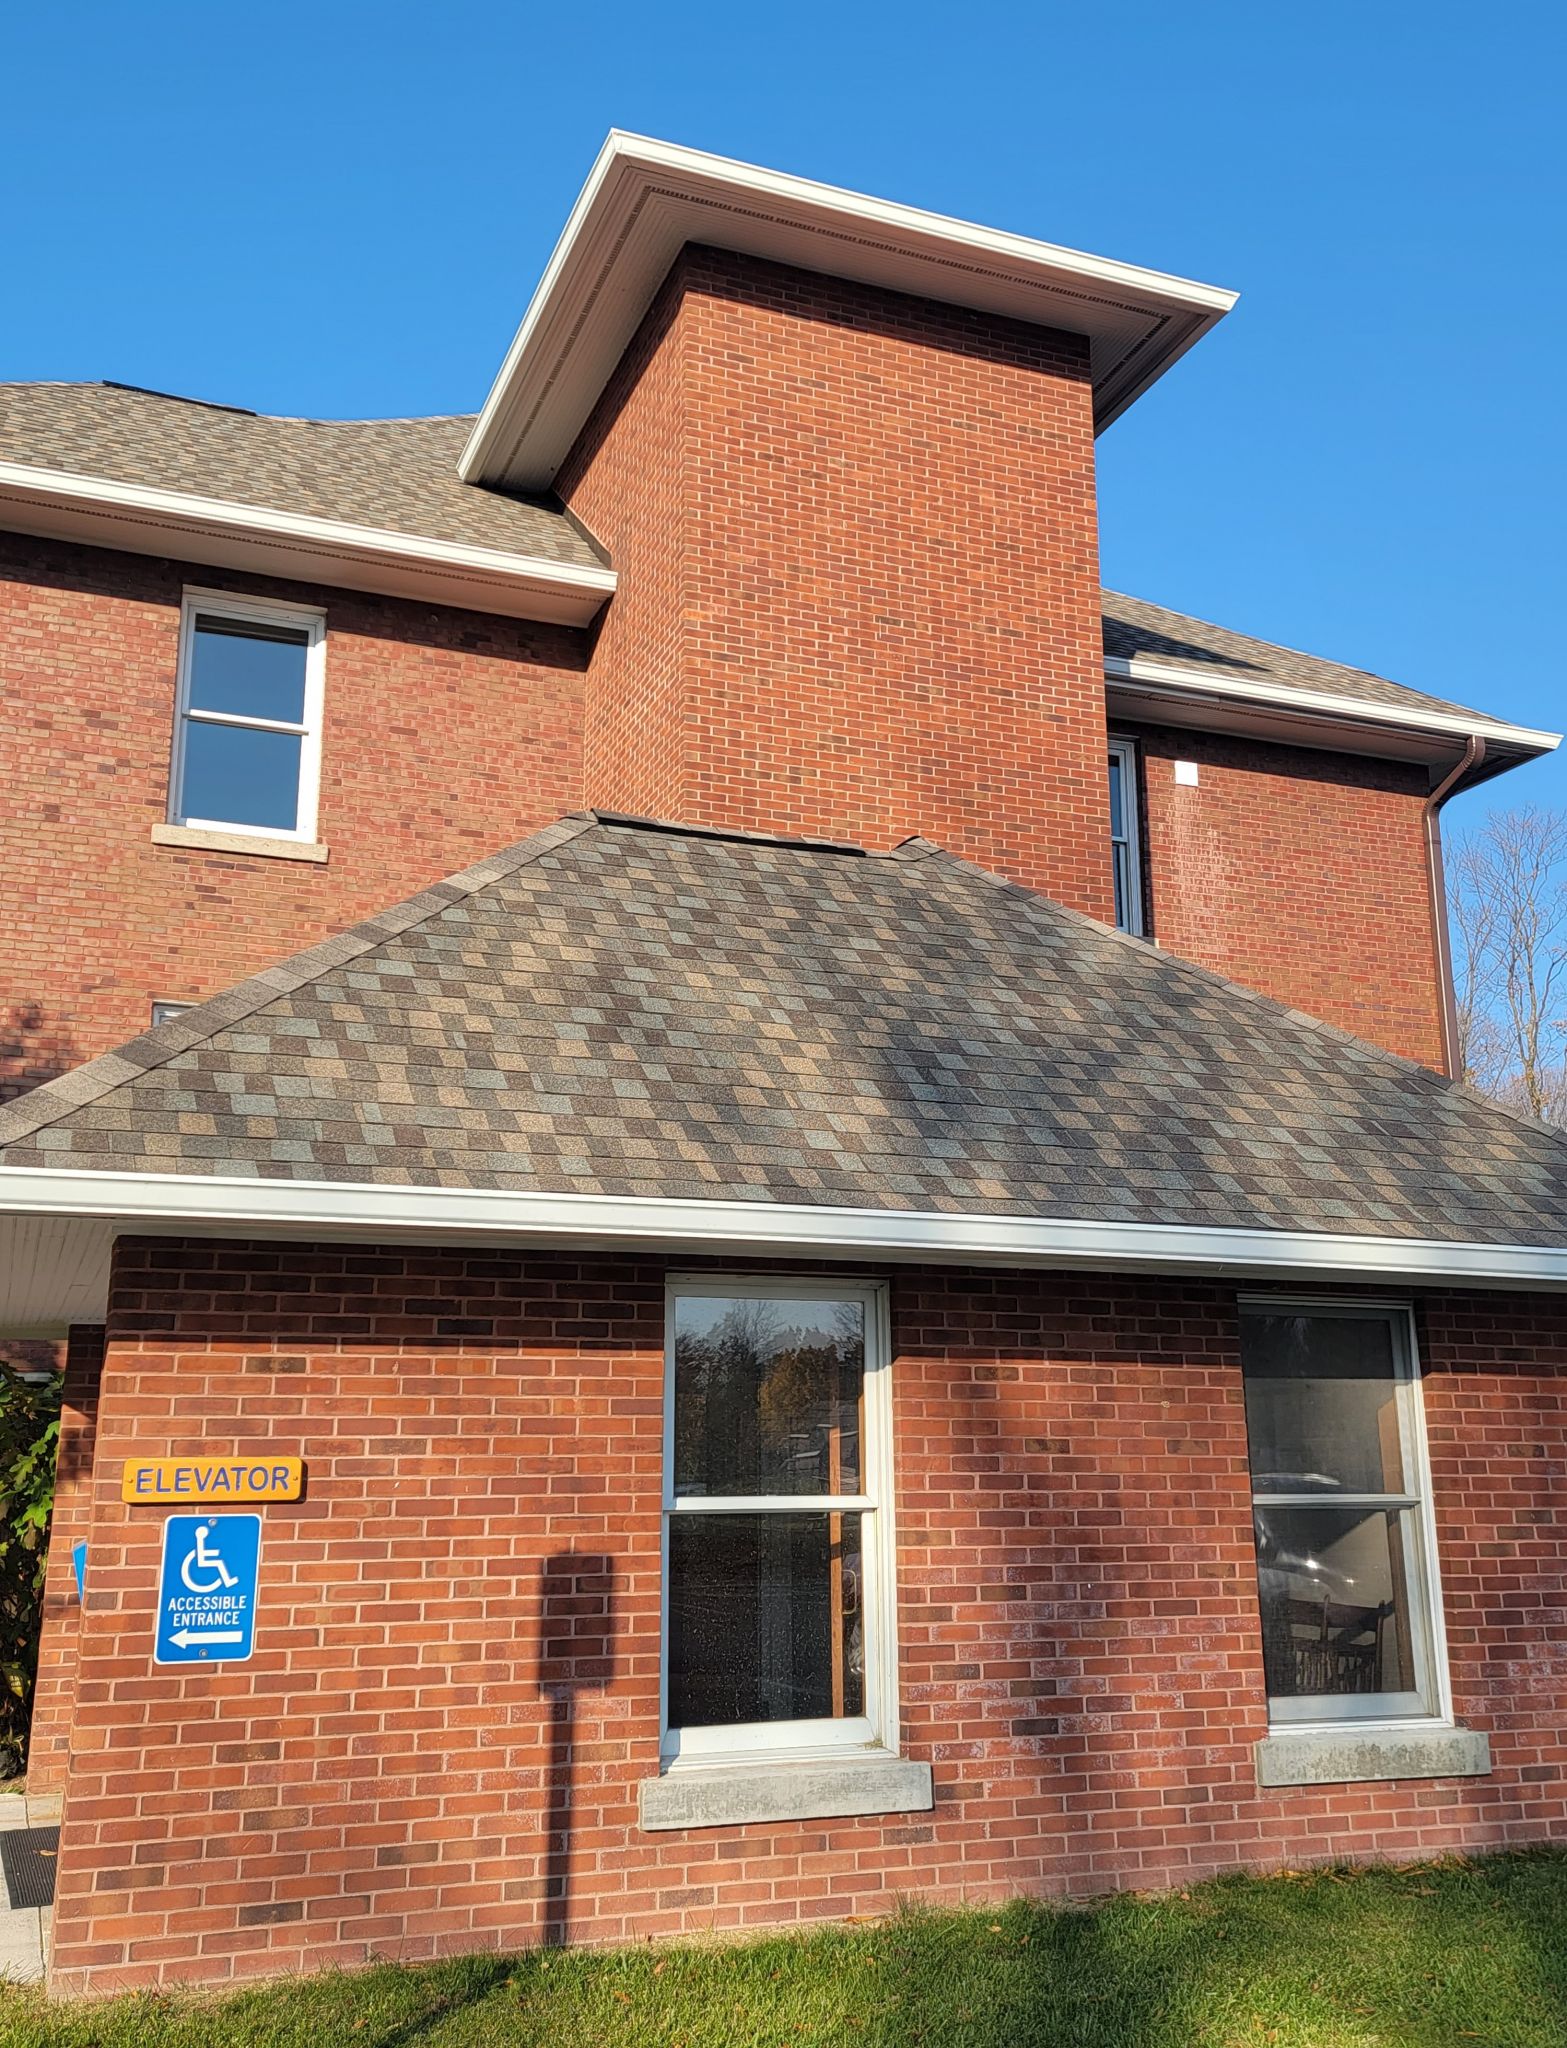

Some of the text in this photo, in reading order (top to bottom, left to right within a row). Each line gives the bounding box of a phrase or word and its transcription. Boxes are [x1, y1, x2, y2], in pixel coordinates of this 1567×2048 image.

[136, 1466, 289, 1493] ELEVATOR
[168, 1595, 247, 1611] ACCESSIBLE
[173, 1611, 240, 1627] ENTRANCE
